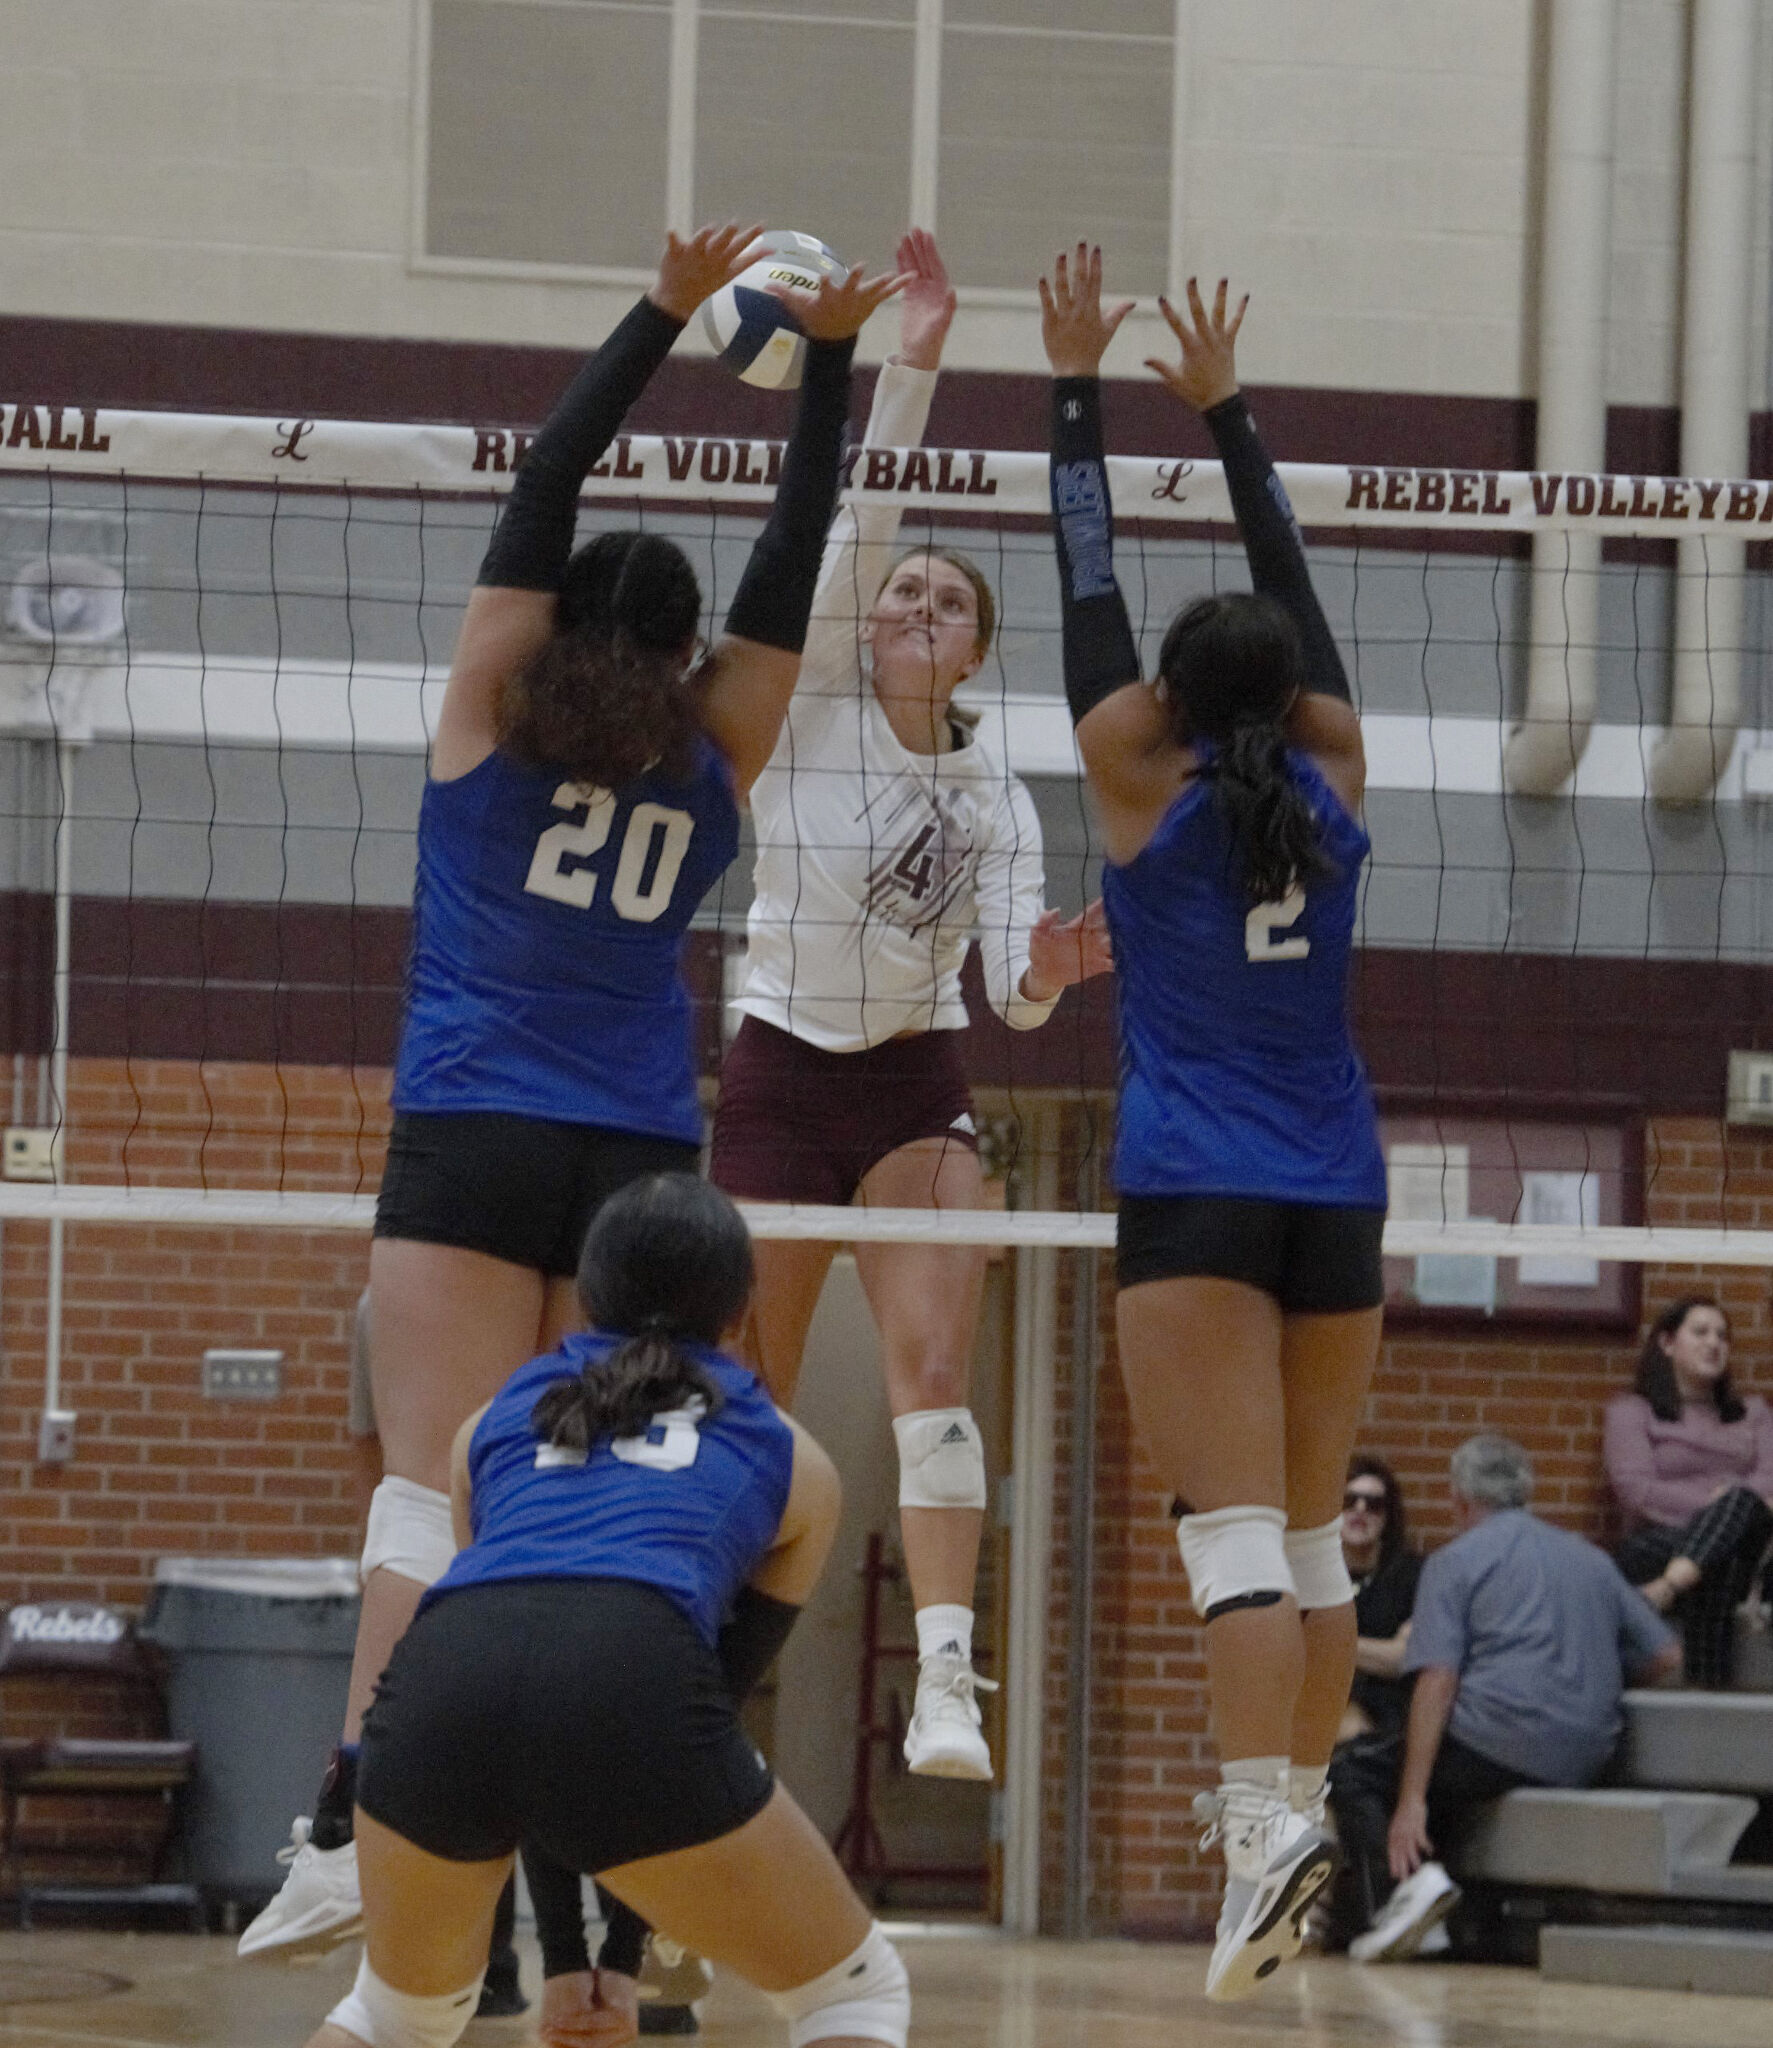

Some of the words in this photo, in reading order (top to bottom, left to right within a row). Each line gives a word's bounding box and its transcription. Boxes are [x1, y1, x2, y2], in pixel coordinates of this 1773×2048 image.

[767, 267, 822, 292] aden
[0, 405, 110, 452] ALL
[271, 419, 314, 462] L
[1151, 459, 1193, 503] L
[1345, 469, 1511, 514] REBEL
[524, 781, 696, 922] 20
[892, 822, 938, 901] 4
[1244, 868, 1311, 963] 2
[8, 1604, 121, 1643] Rebels
